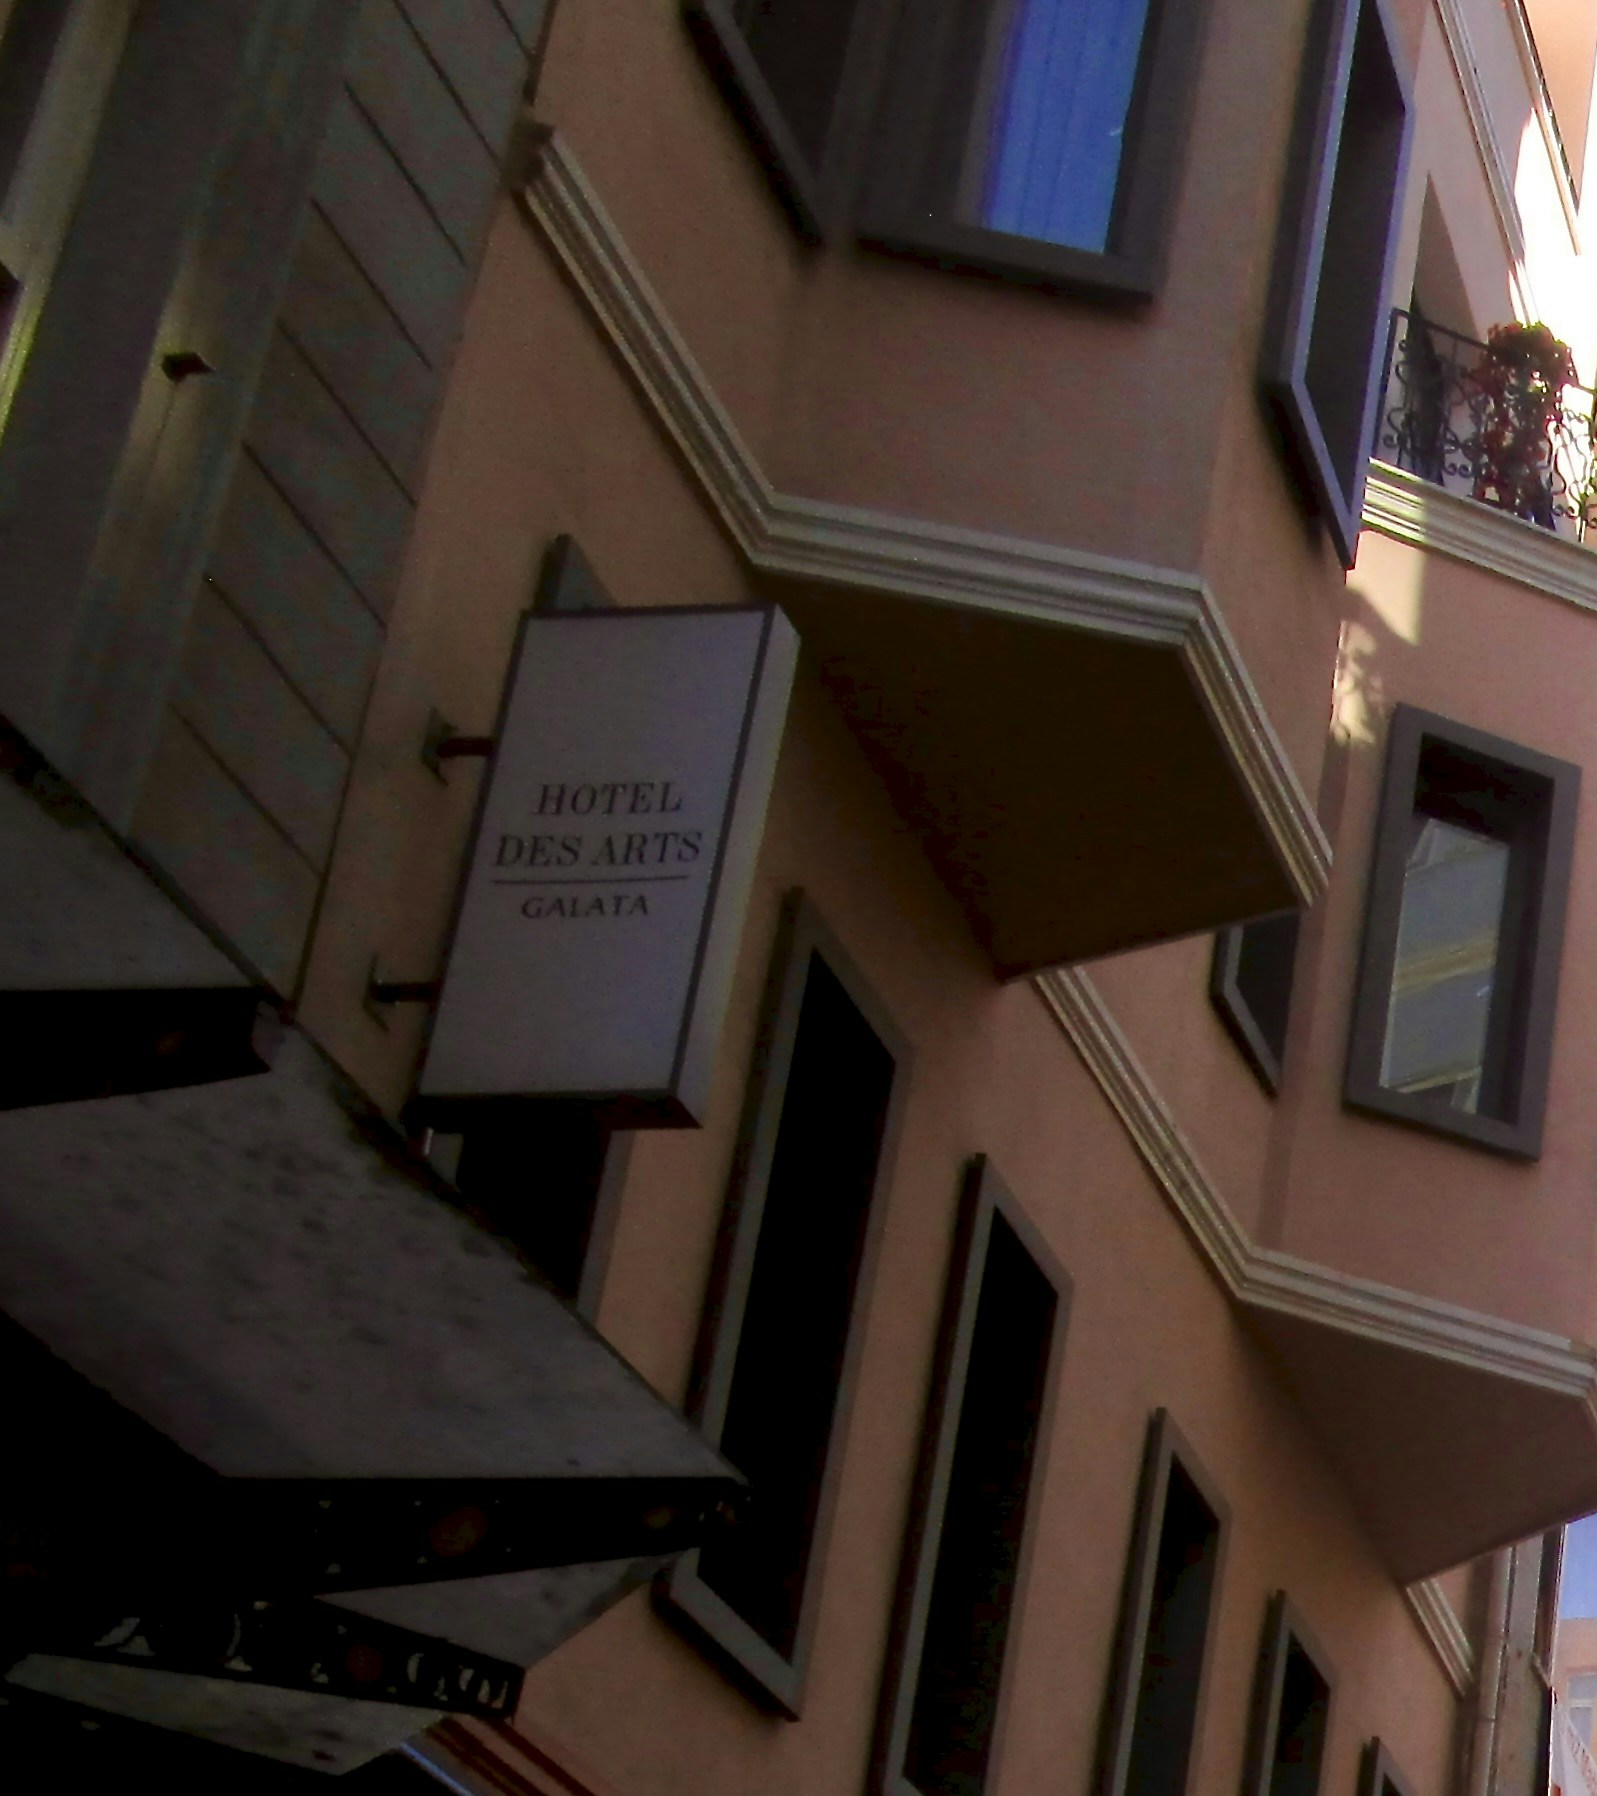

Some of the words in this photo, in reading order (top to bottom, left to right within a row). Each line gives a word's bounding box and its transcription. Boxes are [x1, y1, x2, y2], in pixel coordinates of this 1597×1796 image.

[533, 781, 682, 815] HOTEL
[493, 834, 582, 867] DES
[592, 830, 702, 865] ARTS
[520, 894, 649, 919] GALATA
